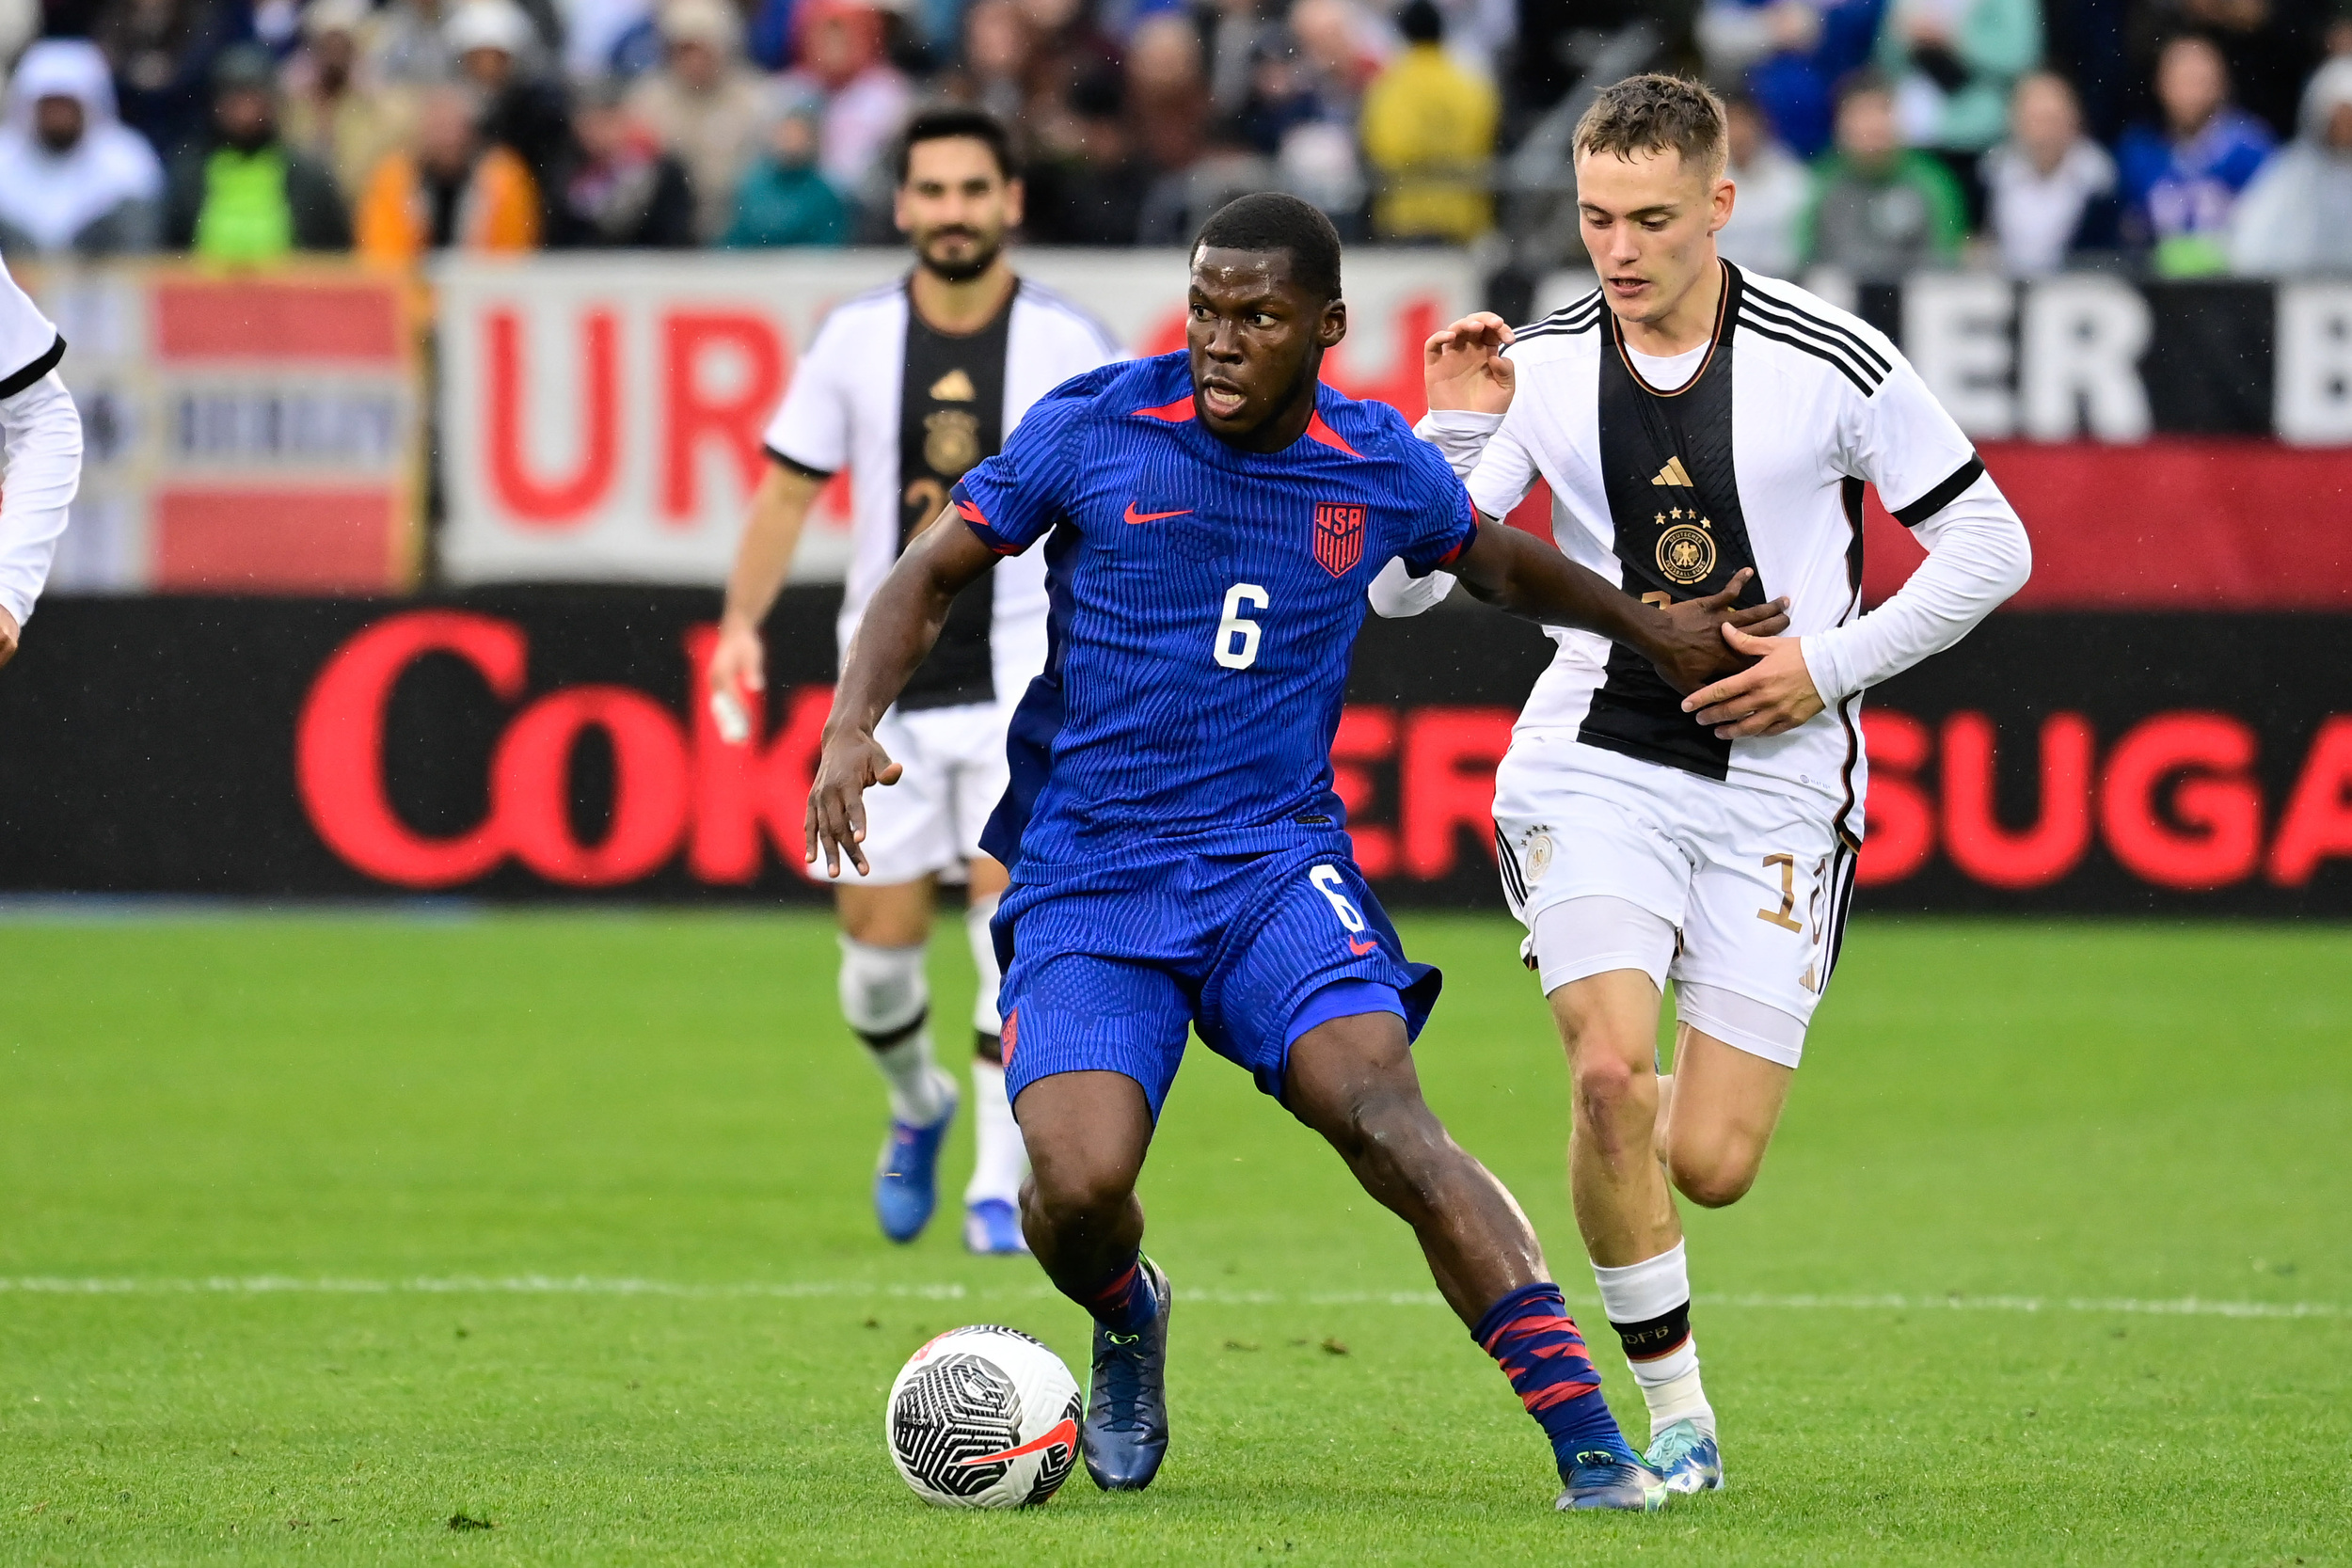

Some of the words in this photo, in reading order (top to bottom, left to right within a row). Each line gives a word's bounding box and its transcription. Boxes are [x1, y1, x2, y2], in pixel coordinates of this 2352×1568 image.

[1318, 506, 1361, 535] USA
[1668, 531, 1703, 545] DEUTSCHER
[1213, 582, 1269, 671] 6
[294, 607, 837, 887] Cok
[1309, 863, 1366, 934] 6
[1756, 852, 1827, 946] 10
[1622, 1325, 1669, 1345] DFB
